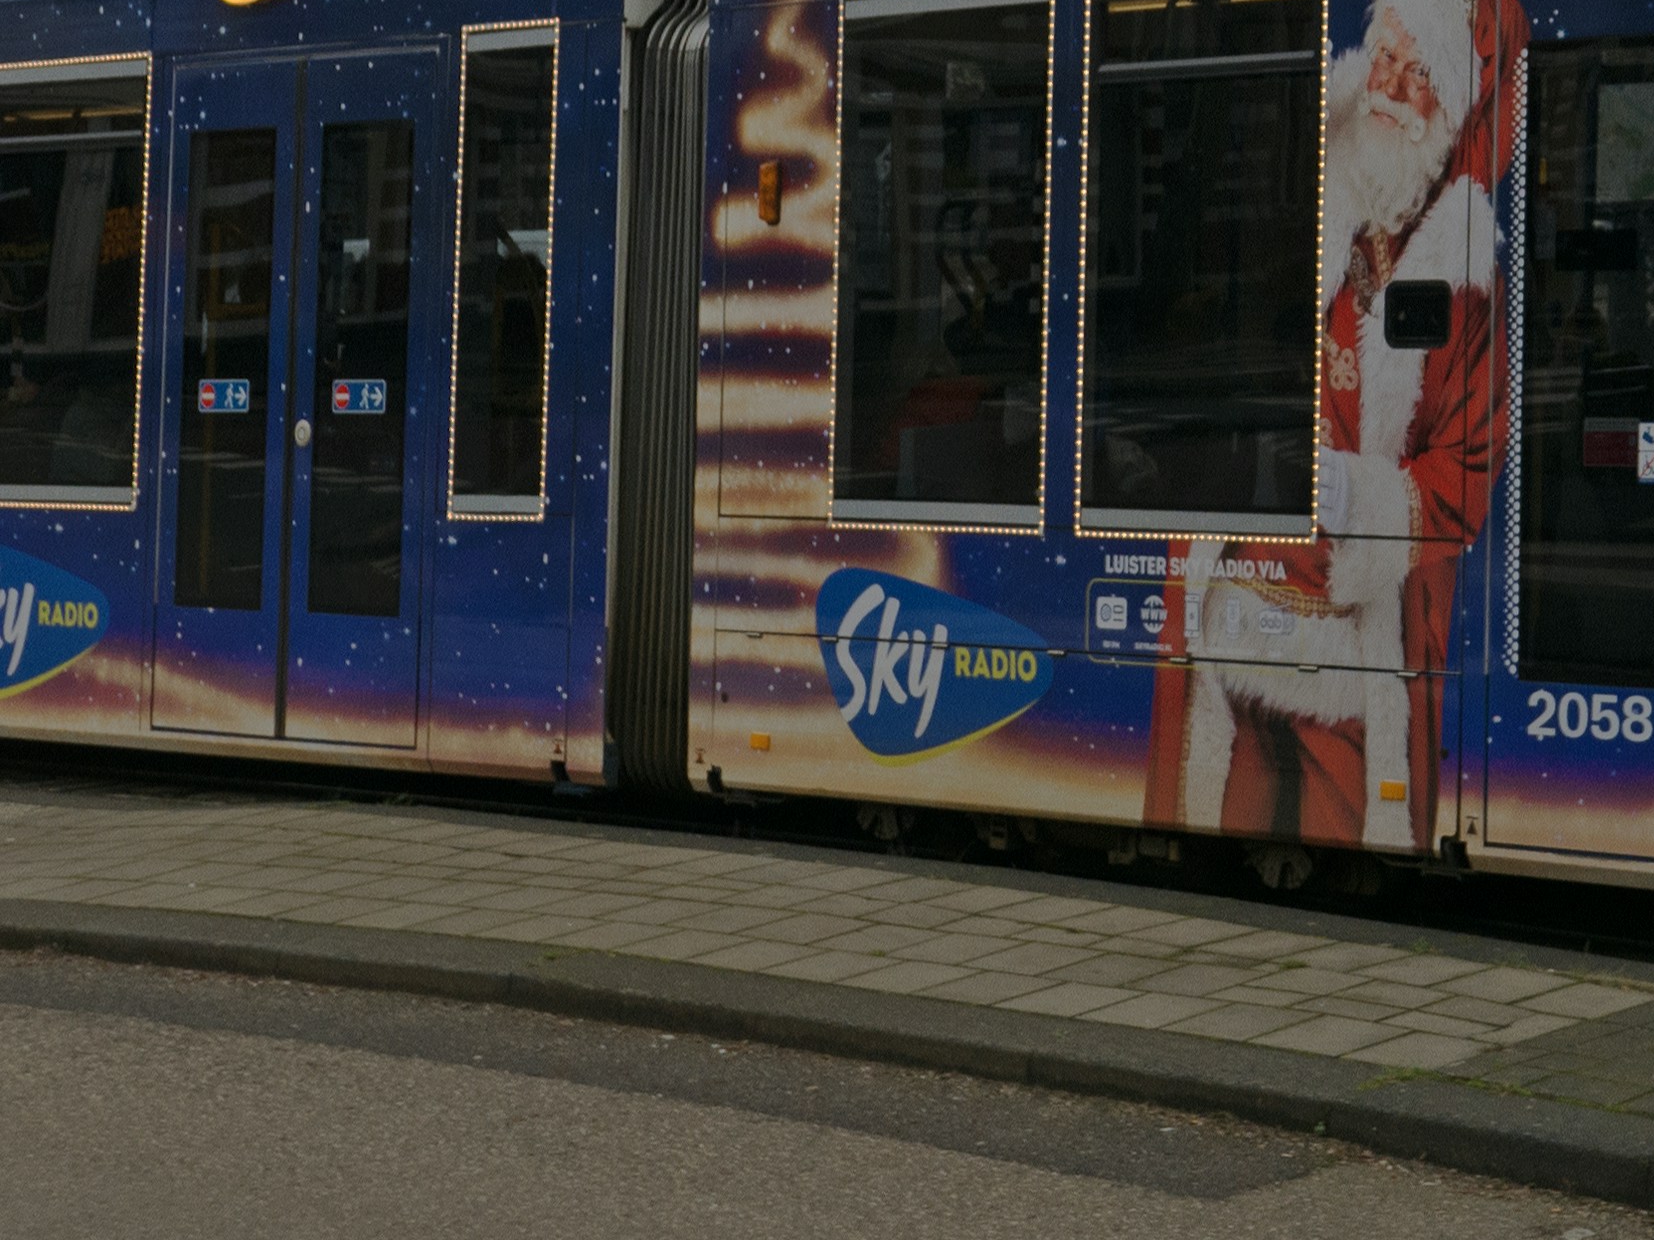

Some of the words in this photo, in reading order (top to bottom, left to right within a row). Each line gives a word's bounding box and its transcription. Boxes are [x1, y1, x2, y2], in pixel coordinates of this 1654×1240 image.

[1105, 554, 1167, 576] LUISTER
[1257, 560, 1287, 580] VIA
[38, 600, 99, 629] RADIO
[836, 583, 948, 739] Sky
[954, 646, 1038, 682] RADIO
[1527, 690, 1653, 742] 2058
